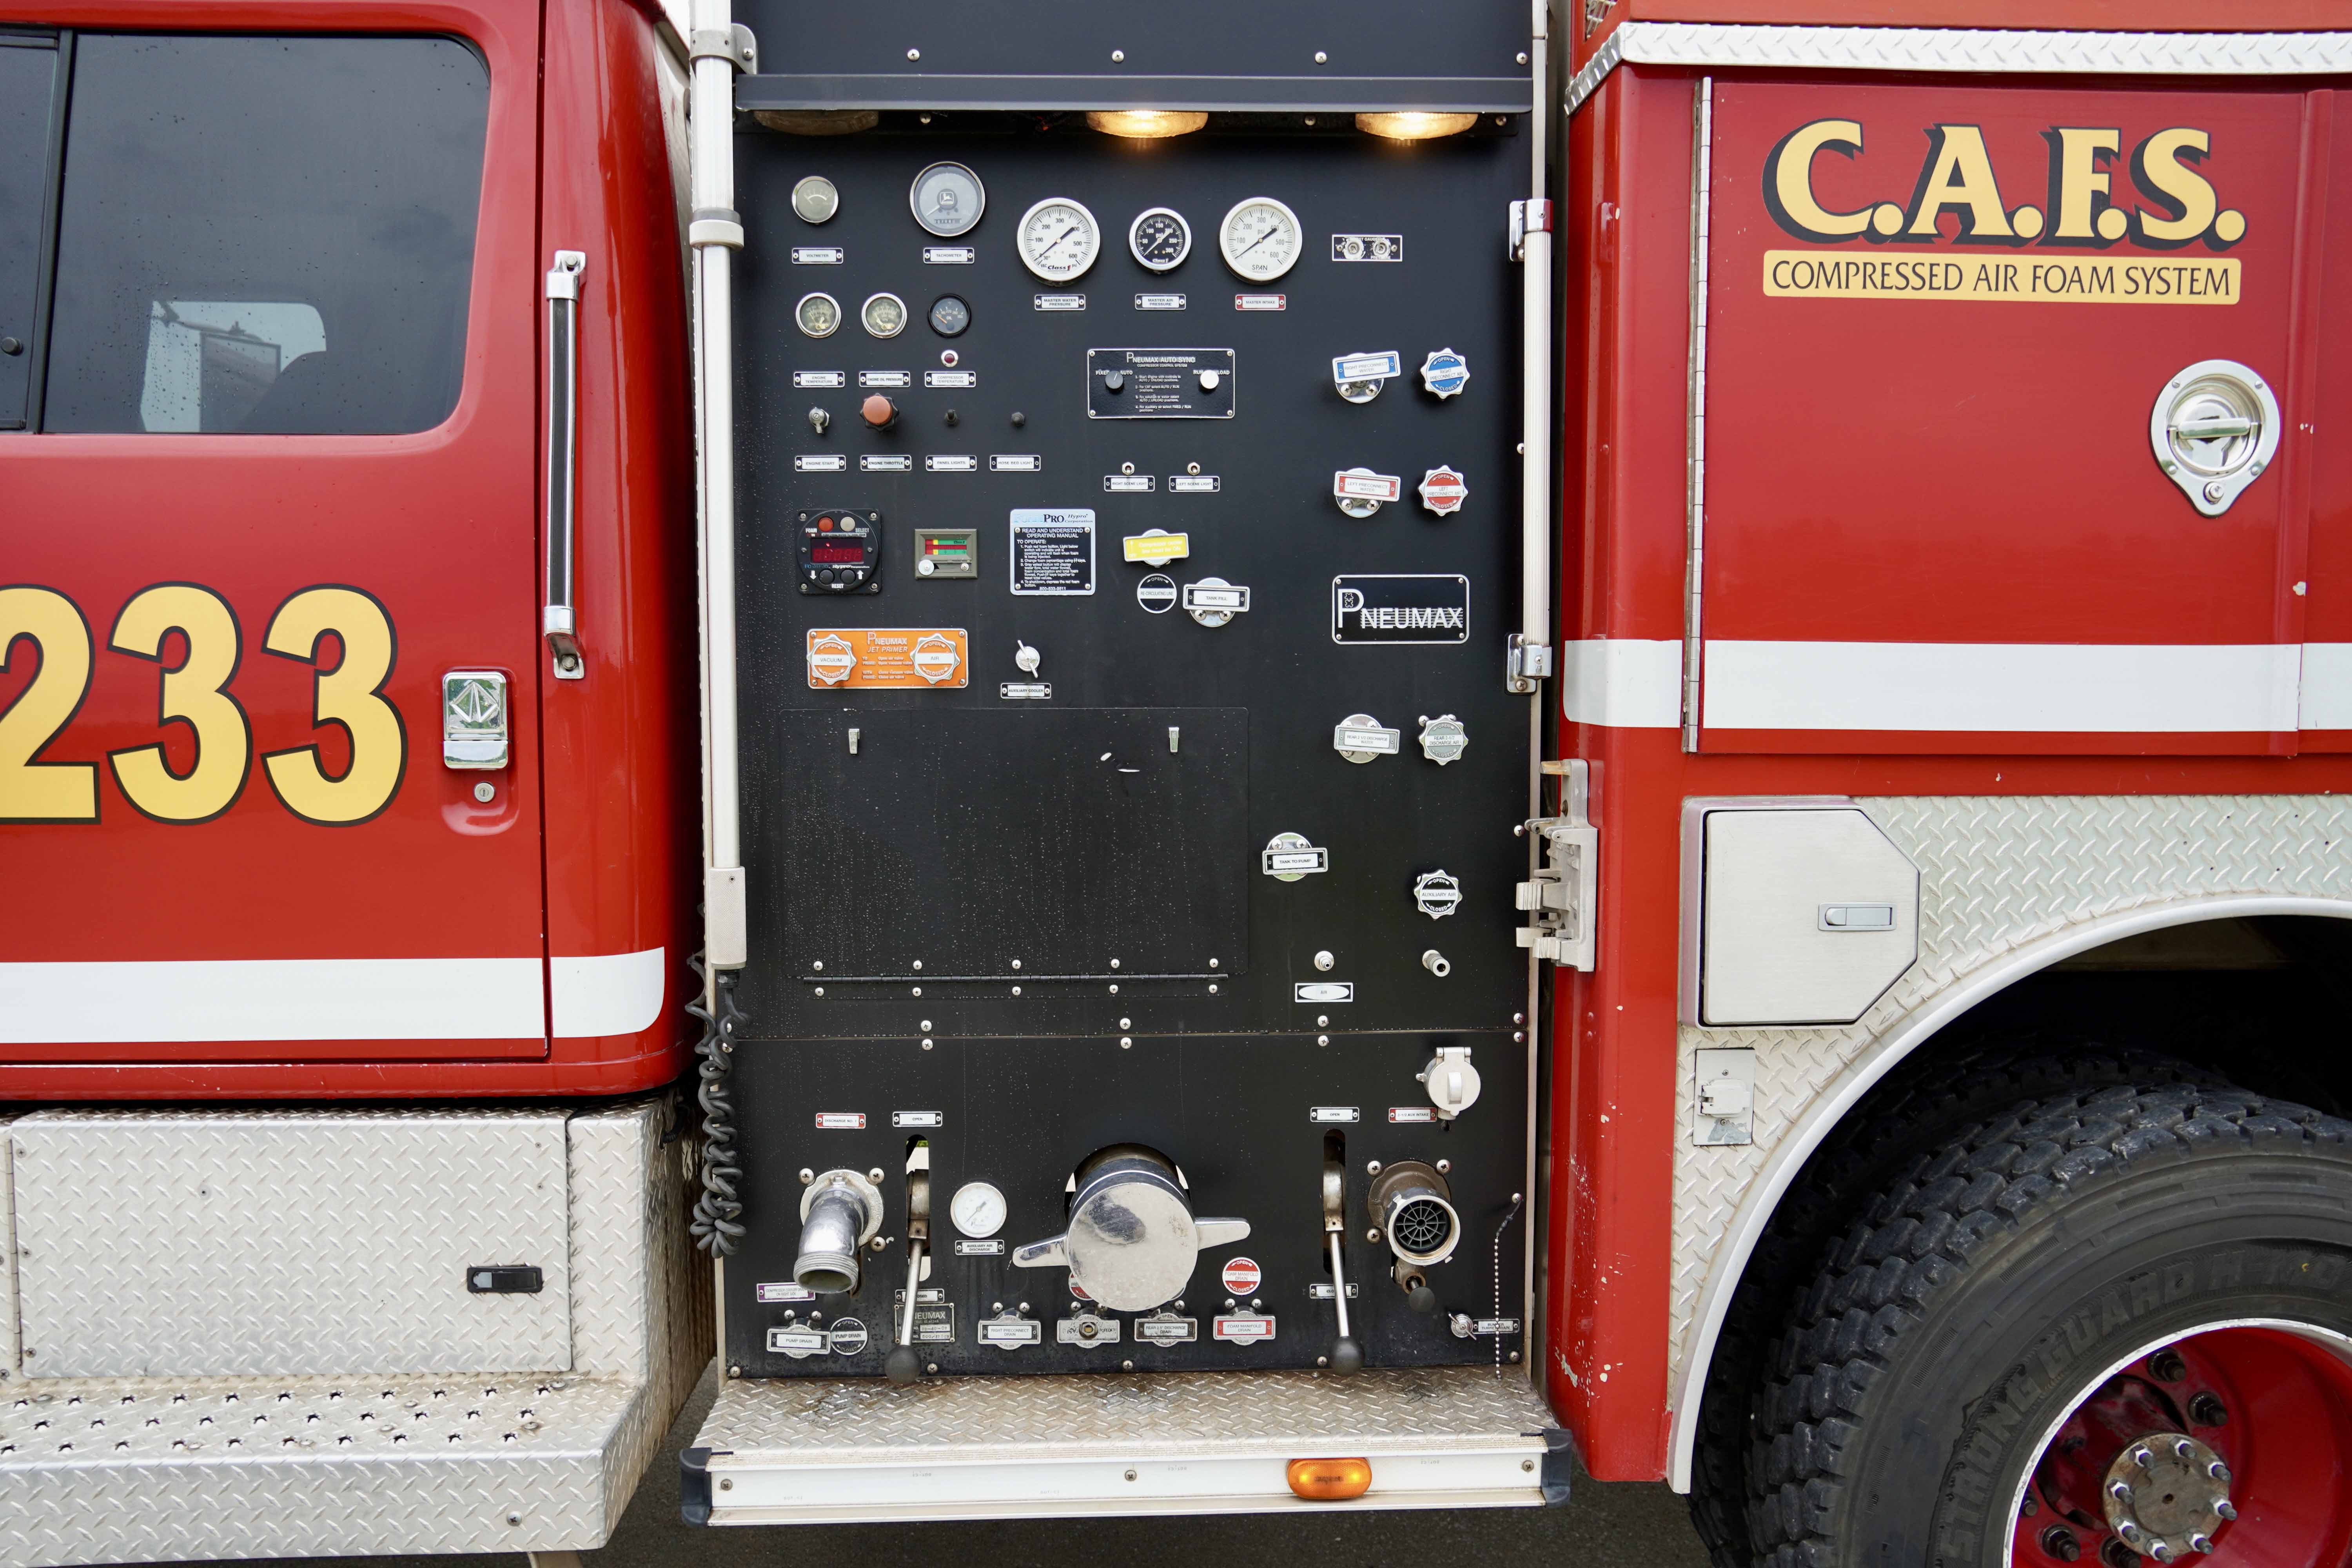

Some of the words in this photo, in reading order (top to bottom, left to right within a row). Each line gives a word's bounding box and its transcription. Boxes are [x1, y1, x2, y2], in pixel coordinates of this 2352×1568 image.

[1763, 118, 2247, 250] C.A.F.S.
[1772, 260, 1962, 291] COMPRESSED
[1973, 263, 2019, 292] AIR
[2032, 265, 2114, 294] FOAM
[2124, 266, 2230, 296] SYSTEM
[1127, 352, 1158, 363] PNEUMAX
[867, 632, 907, 645] PNEUMAX
[1338, 588, 1463, 629] PNEUMAX
[0, 581, 408, 828] 233
[2038, 1263, 2194, 1378] GUARD
[1940, 1370, 2042, 1562] STRONG
